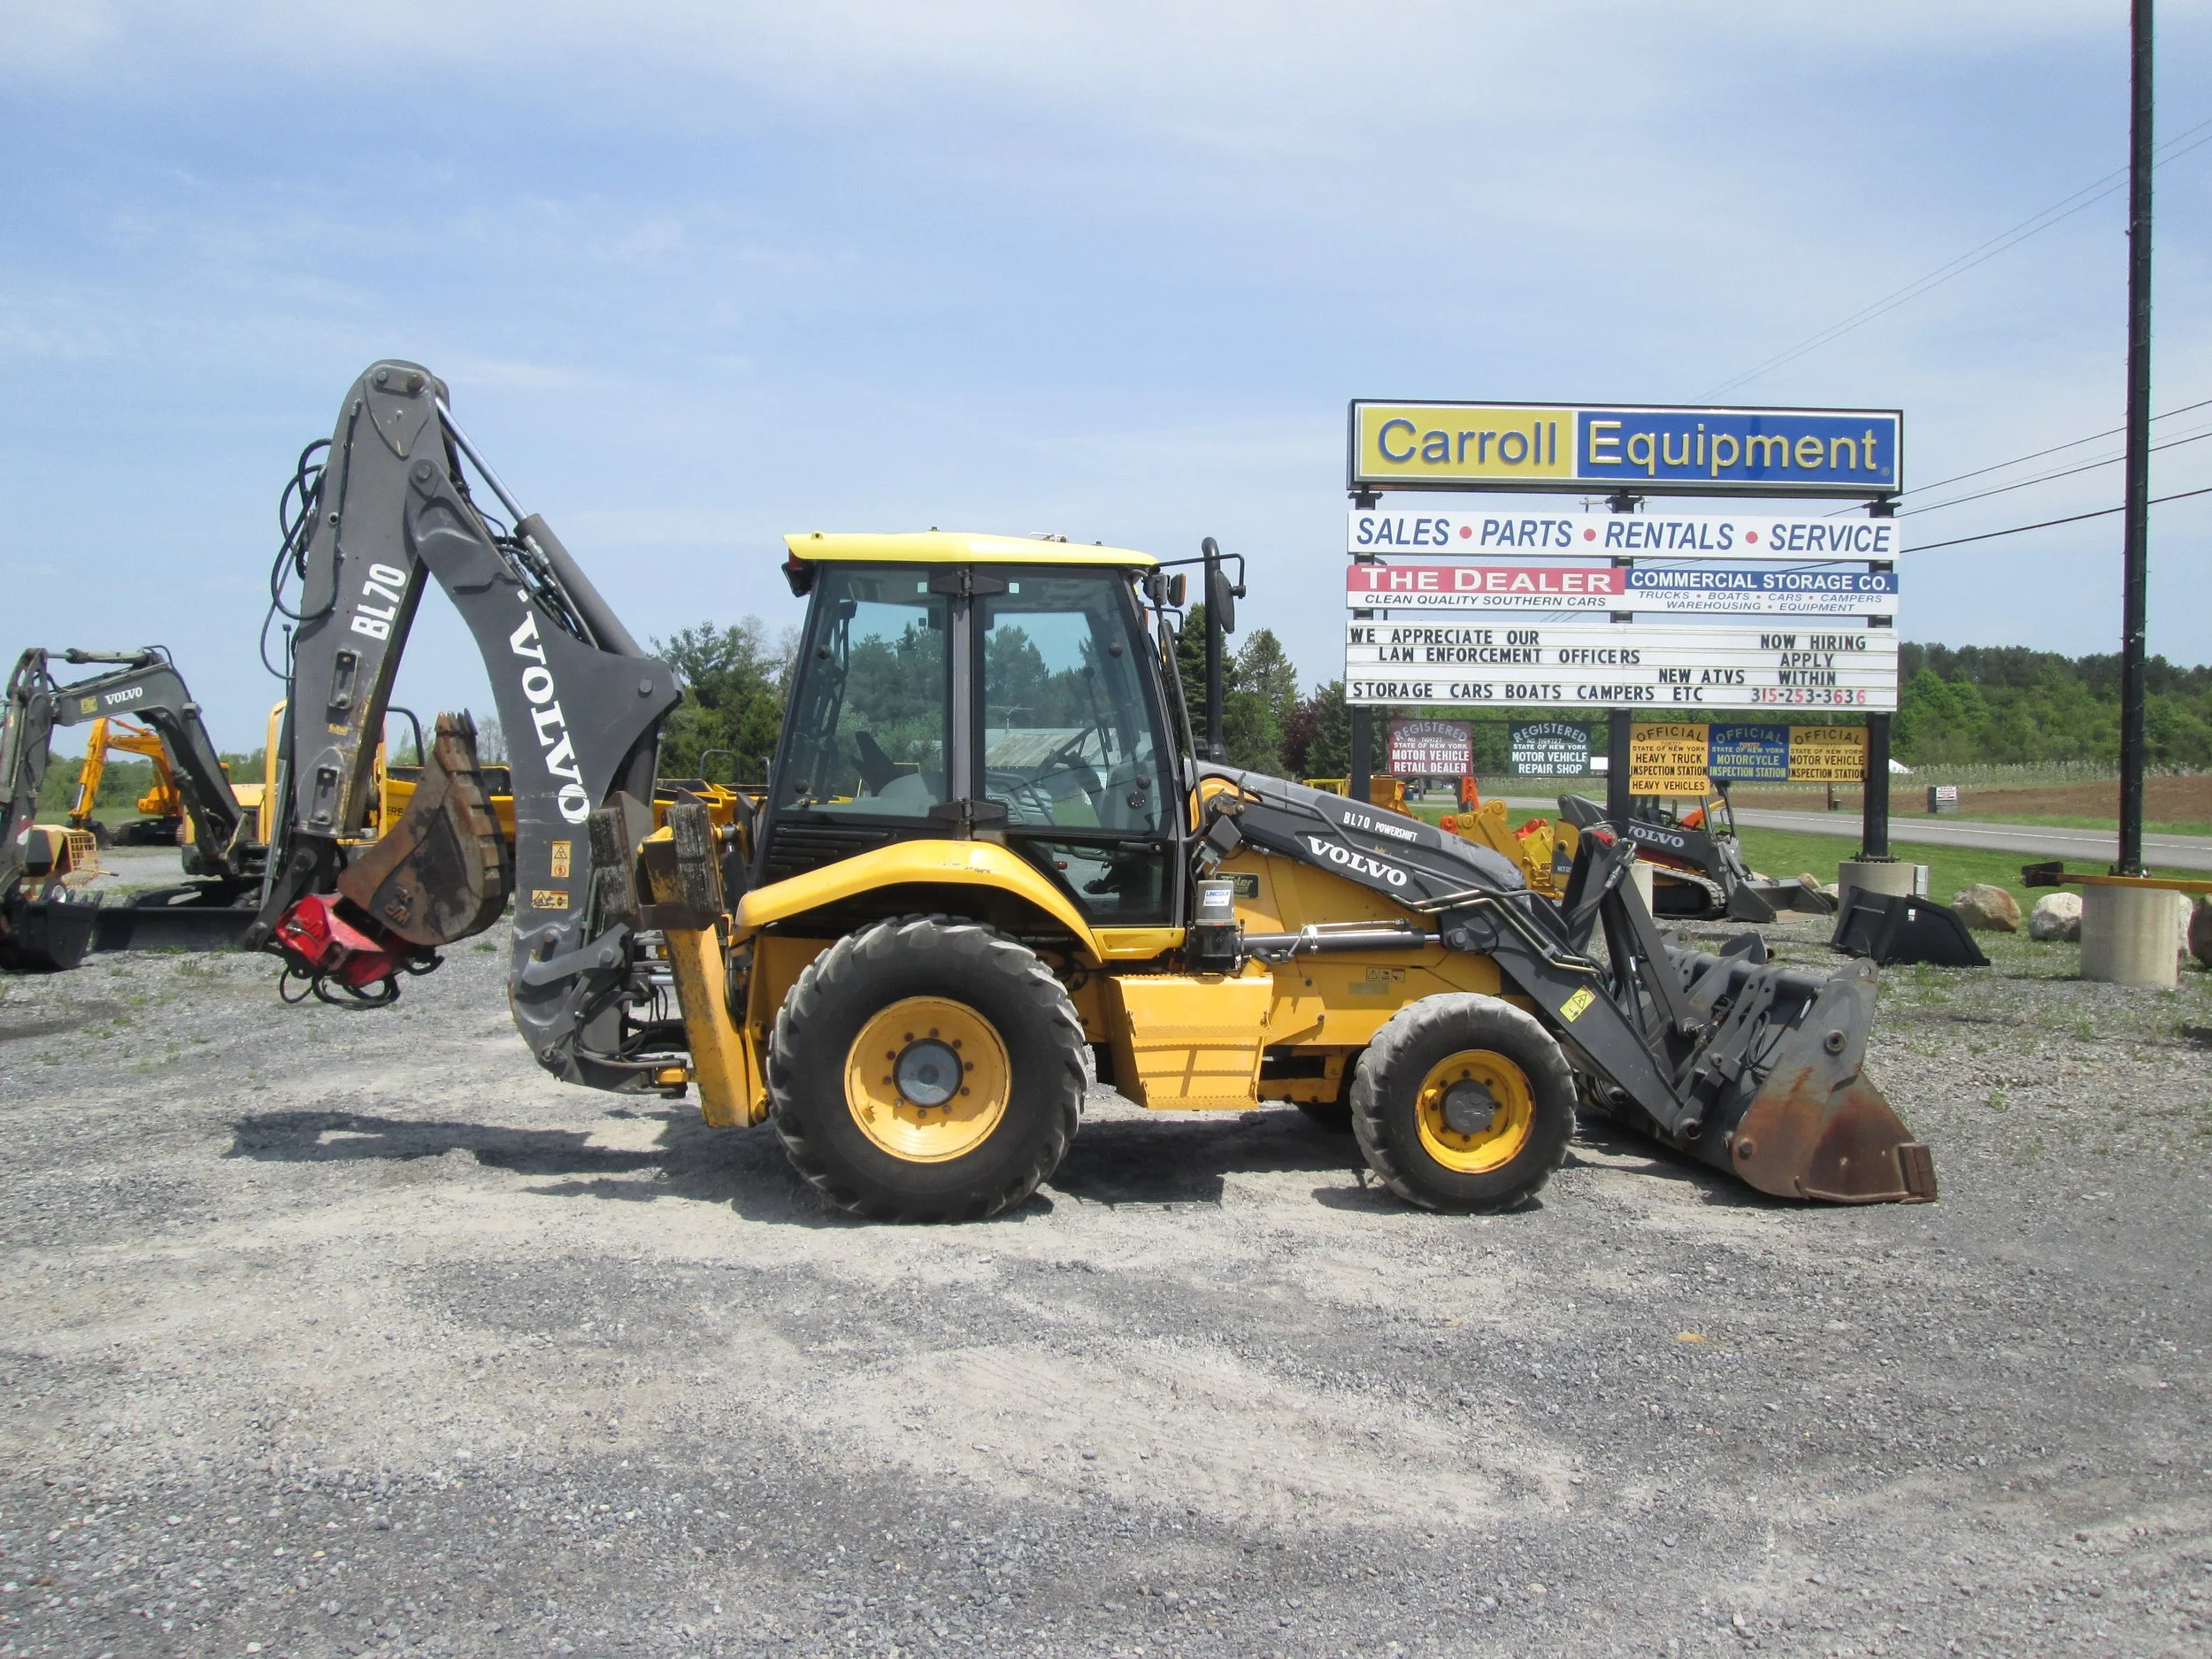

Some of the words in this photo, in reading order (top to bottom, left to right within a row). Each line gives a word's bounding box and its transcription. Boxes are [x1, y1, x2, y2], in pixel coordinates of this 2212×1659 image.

[1378, 418, 1557, 466] Carroll
[1588, 420, 1877, 477] Equipment
[1356, 517, 1451, 546] SALES
[1479, 518, 1573, 548] PARTS
[1604, 520, 1734, 550] RENTALS
[1769, 523, 1892, 553] SERVICE
[1361, 567, 1440, 591] THE
[1454, 568, 1612, 593] DEALER
[1631, 572, 1757, 589] COMMERCIAL
[1763, 573, 1854, 591] STORAGE
[1858, 575, 1891, 591] CO.
[350, 563, 407, 641] BL70
[1364, 594, 1413, 604] CLEAN
[1417, 595, 1479, 606] QUALITY
[1483, 595, 1563, 607] SOUTHERN
[1566, 596, 1607, 608] CARS
[1639, 590, 1690, 600] TRUCKS
[1708, 592, 1750, 601] BOATS
[1768, 593, 1803, 602] CARS
[1820, 594, 1883, 603] CAMPERS
[1666, 600, 1762, 611] WAREHOUSING
[1778, 603, 1855, 612] EQUIPMENT
[1350, 627, 1376, 643] WE
[1391, 628, 1494, 645] APPRECIATE
[1506, 630, 1540, 646] OUR
[1760, 634, 1796, 649] NOW
[1809, 635, 1866, 651] HIRING
[1379, 646, 1414, 662] LAW
[1425, 647, 1542, 664] ENFORCEMENT
[1558, 649, 1640, 664] OFFICERS
[1779, 652, 1834, 668] APPLY
[1658, 668, 1692, 684] NEW
[1701, 669, 1746, 685] ATVS
[1778, 670, 1836, 686] WITHIN
[104, 687, 143, 705] VOLVO
[1353, 681, 1433, 698] STORAGE
[1449, 683, 1494, 699] CARS
[1505, 683, 1562, 700] BOATS
[1577, 685, 1655, 701] CAMPERS
[1673, 686, 1704, 702] ETC
[1750, 687, 1867, 705] 315-253-3636
[509, 611, 591, 825] VOLVO
[1394, 721, 1467, 741] REGISTERED
[1512, 722, 1586, 743] REGISTERED
[1636, 726, 1704, 743] OFFICIAL
[1716, 727, 1784, 745] OFFICIAL
[1793, 729, 1862, 745] OFFICIAL
[1392, 749, 1425, 760] MOTOR
[1430, 750, 1470, 761] VEHICLE
[1511, 751, 1545, 762] MOTOR
[1547, 752, 1588, 762] VEHICLE
[1635, 753, 1666, 764] HEAVY
[1671, 753, 1702, 764] TRUCK
[1717, 754, 1779, 765] MOTORCYCLE
[1789, 755, 1821, 765] MOTOR
[1824, 756, 1864, 765] VEHICLE
[1394, 762, 1427, 772] RETAIL
[1431, 762, 1467, 773] DEALER
[1518, 764, 1554, 774] REPAIR
[1556, 764, 1583, 774] SHOP
[1631, 765, 1675, 776] INSPECTION
[1677, 765, 1708, 776] STATION
[1709, 766, 1754, 777] INSPECTION
[1755, 767, 1786, 778] STATION
[1789, 768, 1832, 779] INSPECTION
[1834, 769, 1866, 779] STATION
[1632, 780, 1660, 789] HEAVY
[1663, 780, 1705, 791] VEHICLES
[1342, 810, 1371, 829] BL70
[1374, 821, 1418, 842] POWERSHIFT
[1307, 835, 1408, 887] VOLVO
